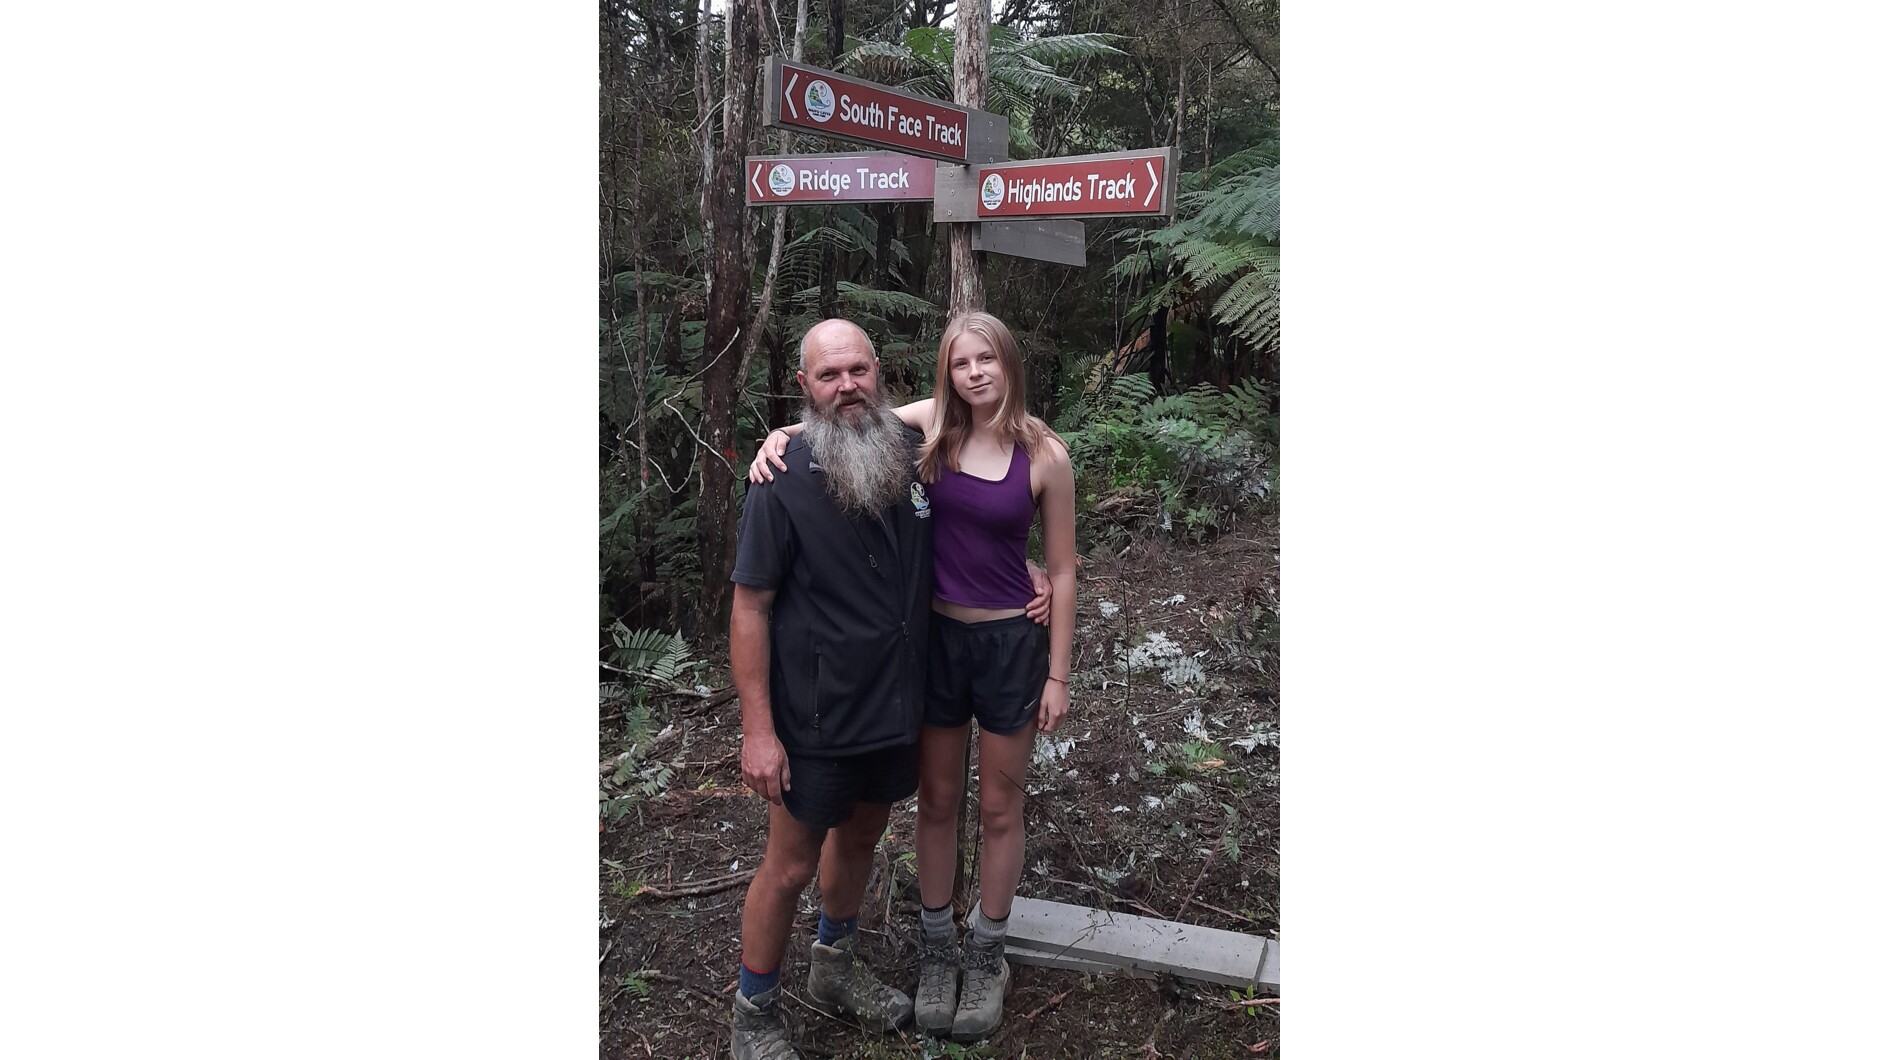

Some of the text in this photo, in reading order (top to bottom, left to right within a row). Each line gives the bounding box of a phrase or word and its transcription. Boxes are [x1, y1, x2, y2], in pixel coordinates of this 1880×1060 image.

[839, 94, 962, 146] South Face Track
[799, 167, 909, 196] Ridge Track
[1007, 172, 1136, 210] Highlands Track
